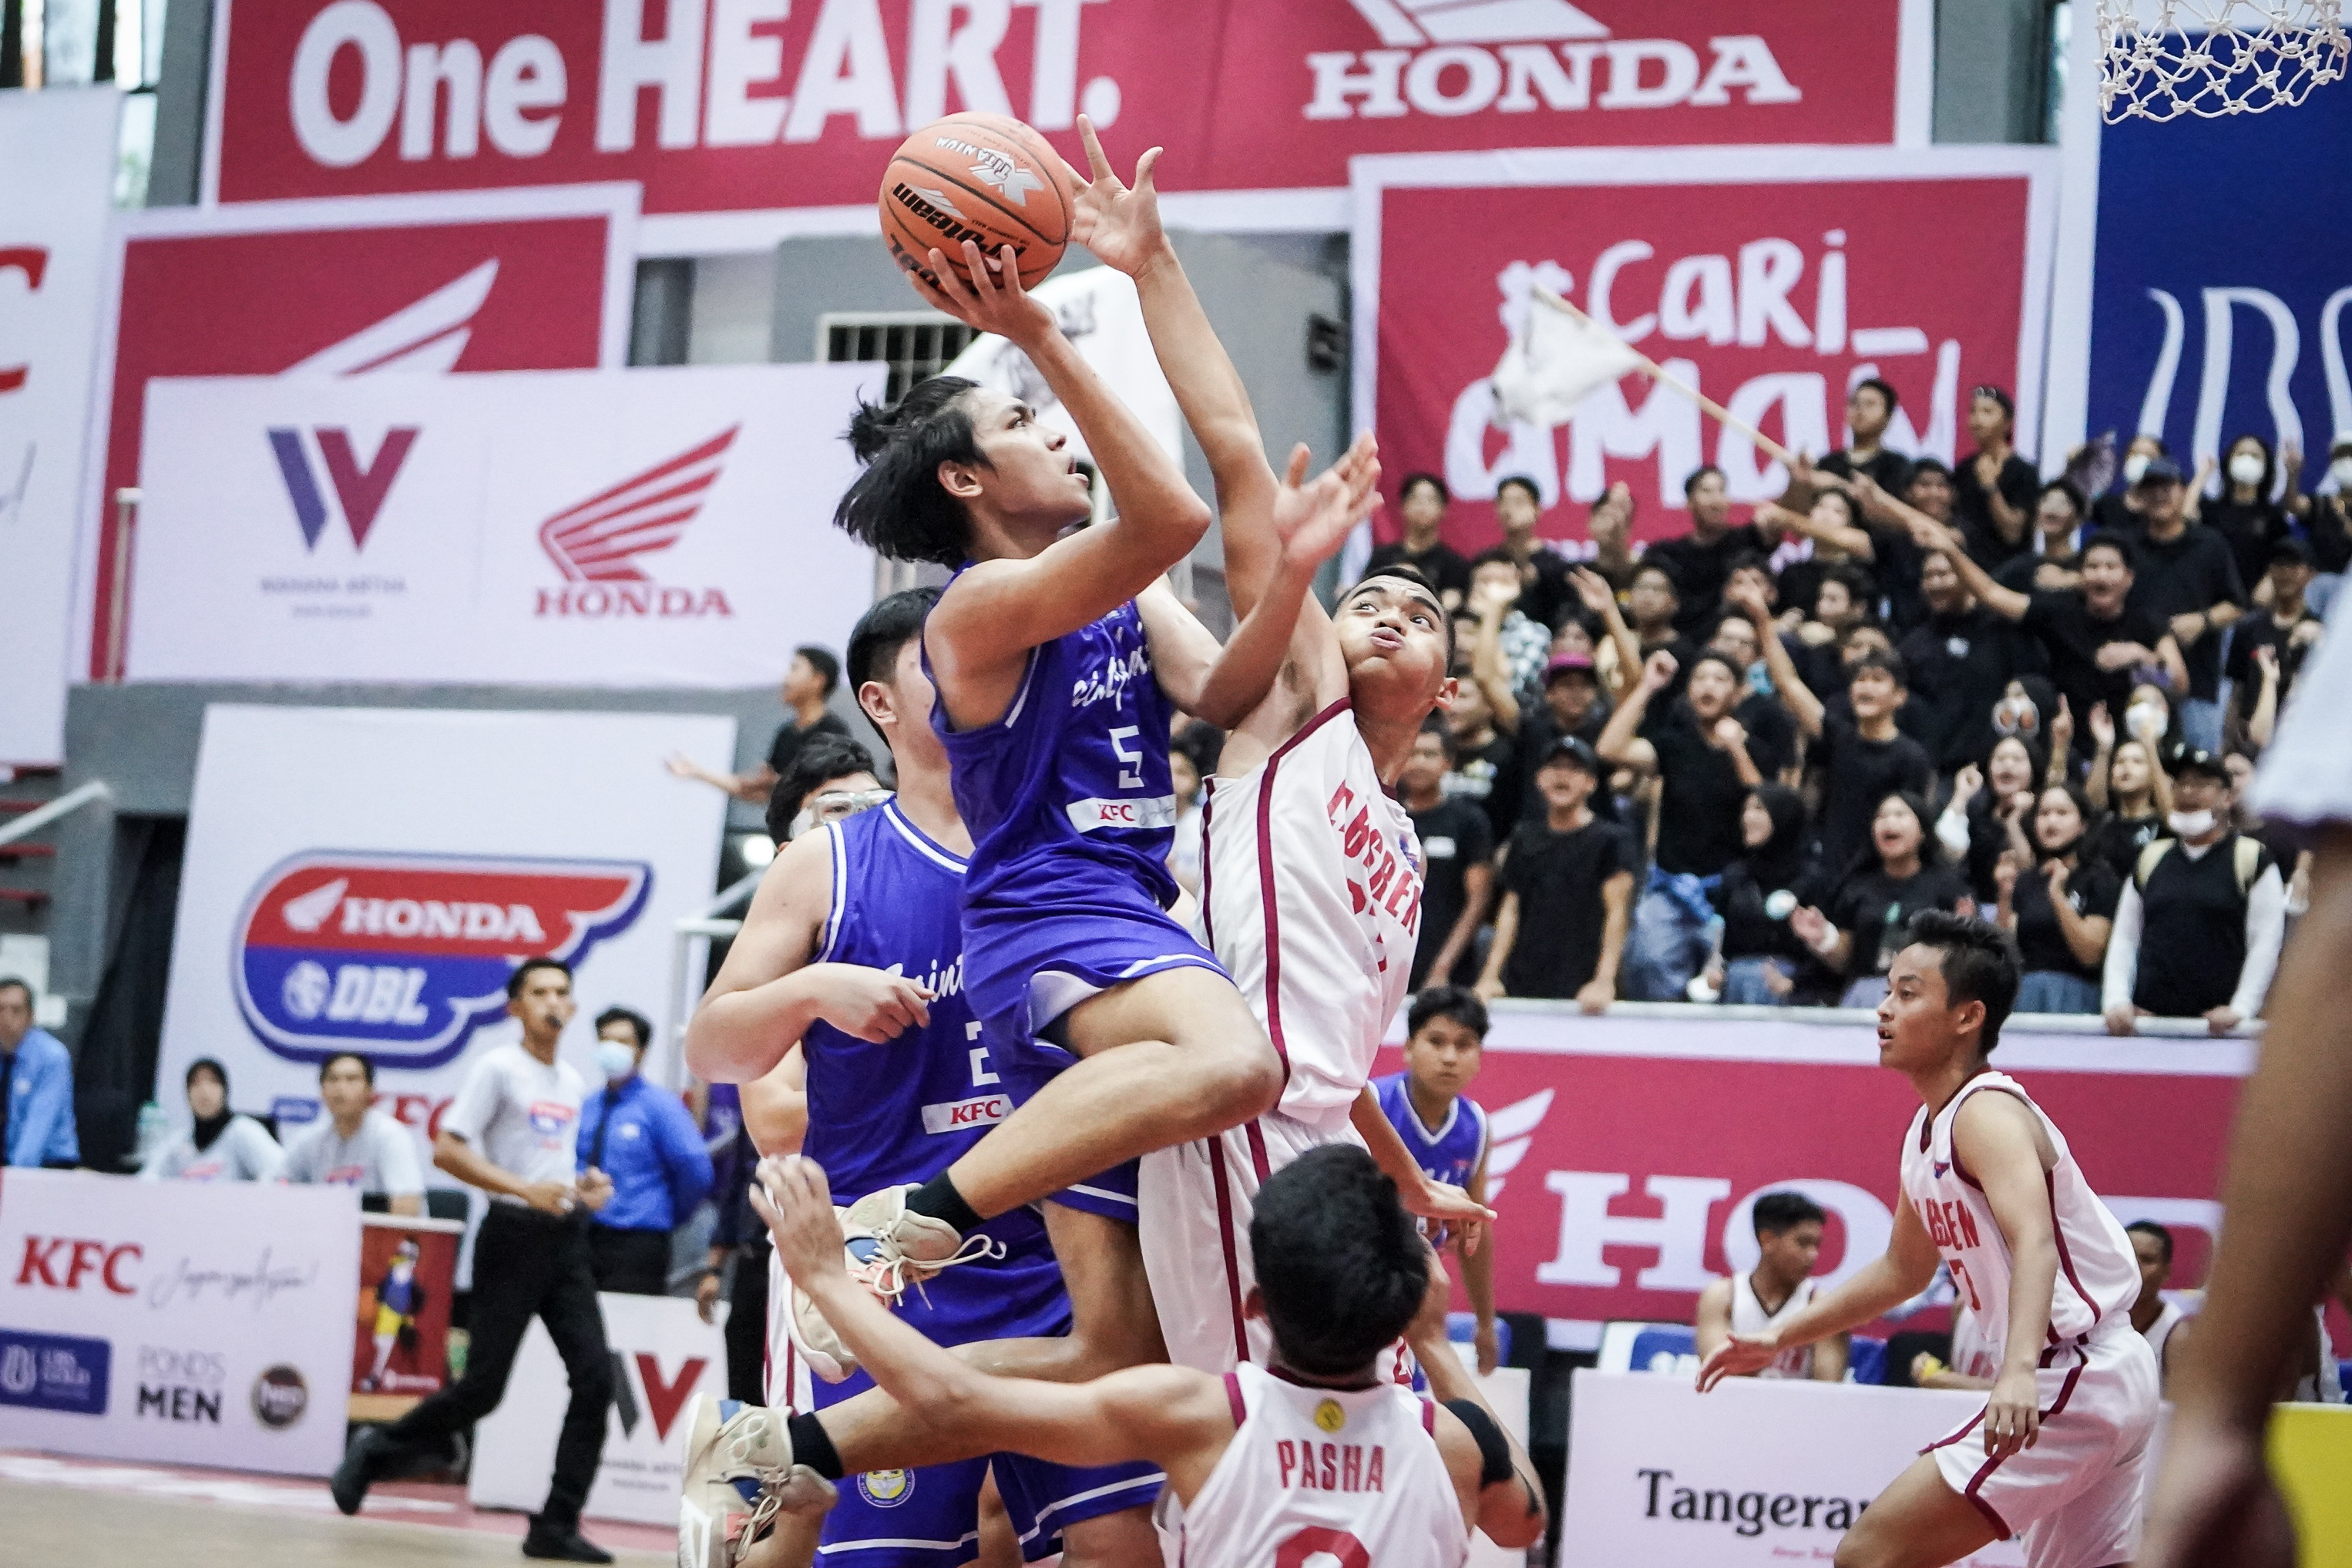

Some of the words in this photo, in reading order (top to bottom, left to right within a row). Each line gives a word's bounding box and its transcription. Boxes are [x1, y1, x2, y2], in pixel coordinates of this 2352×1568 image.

[290, 0, 569, 168] One
[595, 0, 1123, 153] HEART.
[1303, 35, 1803, 119] HONDA
[533, 585, 734, 619] HONDA
[1108, 724, 1145, 789] 5
[1097, 804, 1136, 822] KFC
[341, 896, 546, 944] HONDA
[325, 963, 428, 1026] DBL
[950, 1100, 1002, 1125] KFC
[15, 1235, 144, 1296] KFC
[136, 1383, 222, 1425] MEN
[1276, 1439, 1385, 1493] PASHA
